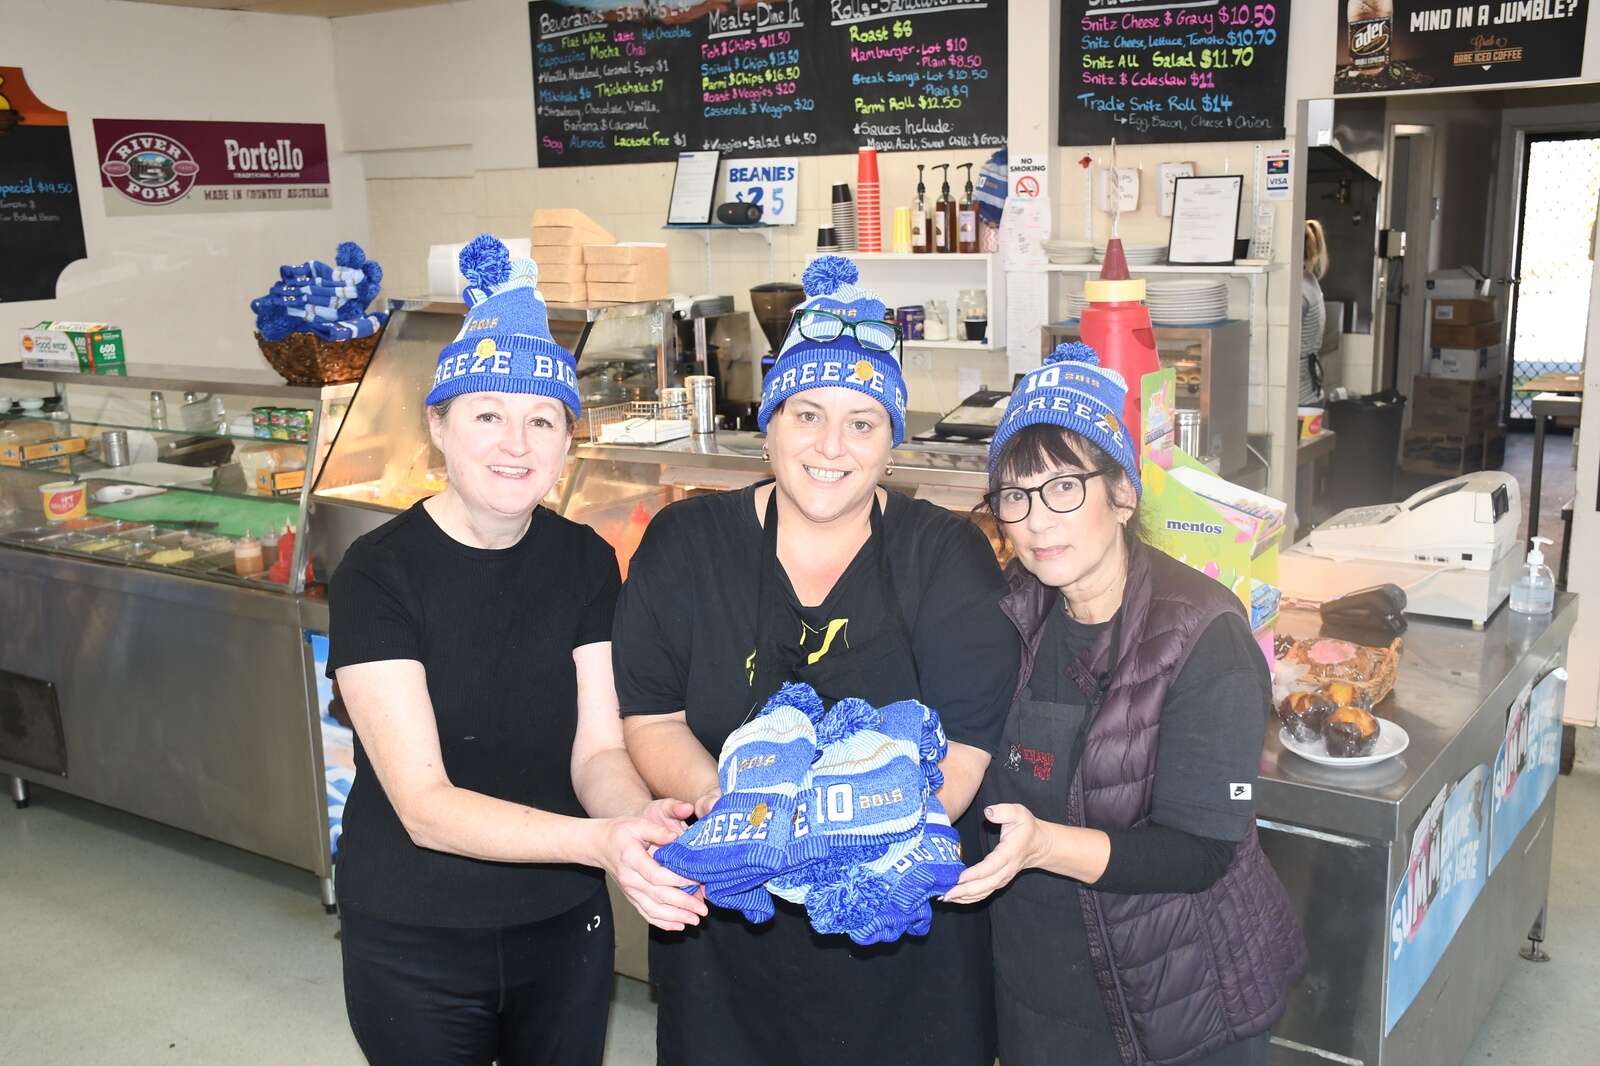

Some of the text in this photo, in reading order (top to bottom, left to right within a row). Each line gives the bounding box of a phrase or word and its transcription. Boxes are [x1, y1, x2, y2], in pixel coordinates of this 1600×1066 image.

[787, 0, 801, 21] In
[1081, 17, 1118, 31] Snitz
[1121, 14, 1161, 30] Cheese
[1176, 10, 1214, 34] Gravy
[1218, 4, 1276, 28] $10.50
[1409, 0, 1578, 33] MIND IN A JUMBLE?
[540, 11, 605, 33] Beverages
[561, 36, 580, 48] Flat
[582, 31, 607, 45] White
[655, 26, 692, 40] Chocolate
[728, 38, 757, 53] Chips
[759, 31, 791, 48] $11.50
[850, 25, 889, 42] Roast
[1081, 28, 1277, 50] Snitz Cheese, Lettuce, Tomato $10.70
[1355, 20, 1386, 49] ader
[590, 44, 621, 59] Mocha
[850, 46, 915, 62] Hamburger
[945, 37, 968, 52] $10
[1082, 54, 1115, 69] Snitz
[1152, 50, 1196, 68] Salad
[1200, 46, 1254, 69] $11.70
[1493, 49, 1522, 61] COFFEE
[603, 61, 631, 76] Caramel
[656, 59, 670, 72] $1
[742, 57, 769, 71] Chips
[769, 49, 800, 66] $13.50
[735, 71, 764, 86] Chips
[765, 66, 801, 82] $16.50
[852, 72, 886, 85] Steak
[887, 70, 920, 87] Sanga
[947, 69, 989, 80] $10.50
[1082, 72, 1117, 86] Snitz
[1131, 72, 1187, 86] Coleslaw
[1190, 71, 1215, 88] $11
[594, 79, 664, 97] Thickshake $7
[703, 91, 731, 102] Roast
[738, 86, 773, 102] Veggies
[775, 82, 796, 95] $20
[951, 85, 969, 98] $9
[703, 103, 748, 117] Casserole
[759, 102, 793, 119] Veggies
[794, 98, 815, 111] $20
[854, 95, 962, 114] Parmi Roll $12.50
[1077, 92, 1233, 112] Tradie Snitz Roll $14
[563, 118, 600, 131] Banana
[609, 116, 649, 130] Caramel
[1190, 114, 1225, 128] Cheese
[1235, 115, 1272, 129] Onion
[116, 137, 182, 160] RIVER
[543, 131, 688, 154] Soy Almond Lactose Free $1
[785, 132, 817, 145] $4.50
[224, 139, 304, 171] Portello
[729, 166, 795, 182] BEANIES
[1270, 177, 1288, 185] VISA
[126, 180, 182, 199] PORT
[204, 189, 229, 200] MADE
[233, 189, 242, 200] IN
[1025, 367, 1060, 394] 10
[1167, 519, 1223, 534] mentos
[817, 782, 854, 824] 10
